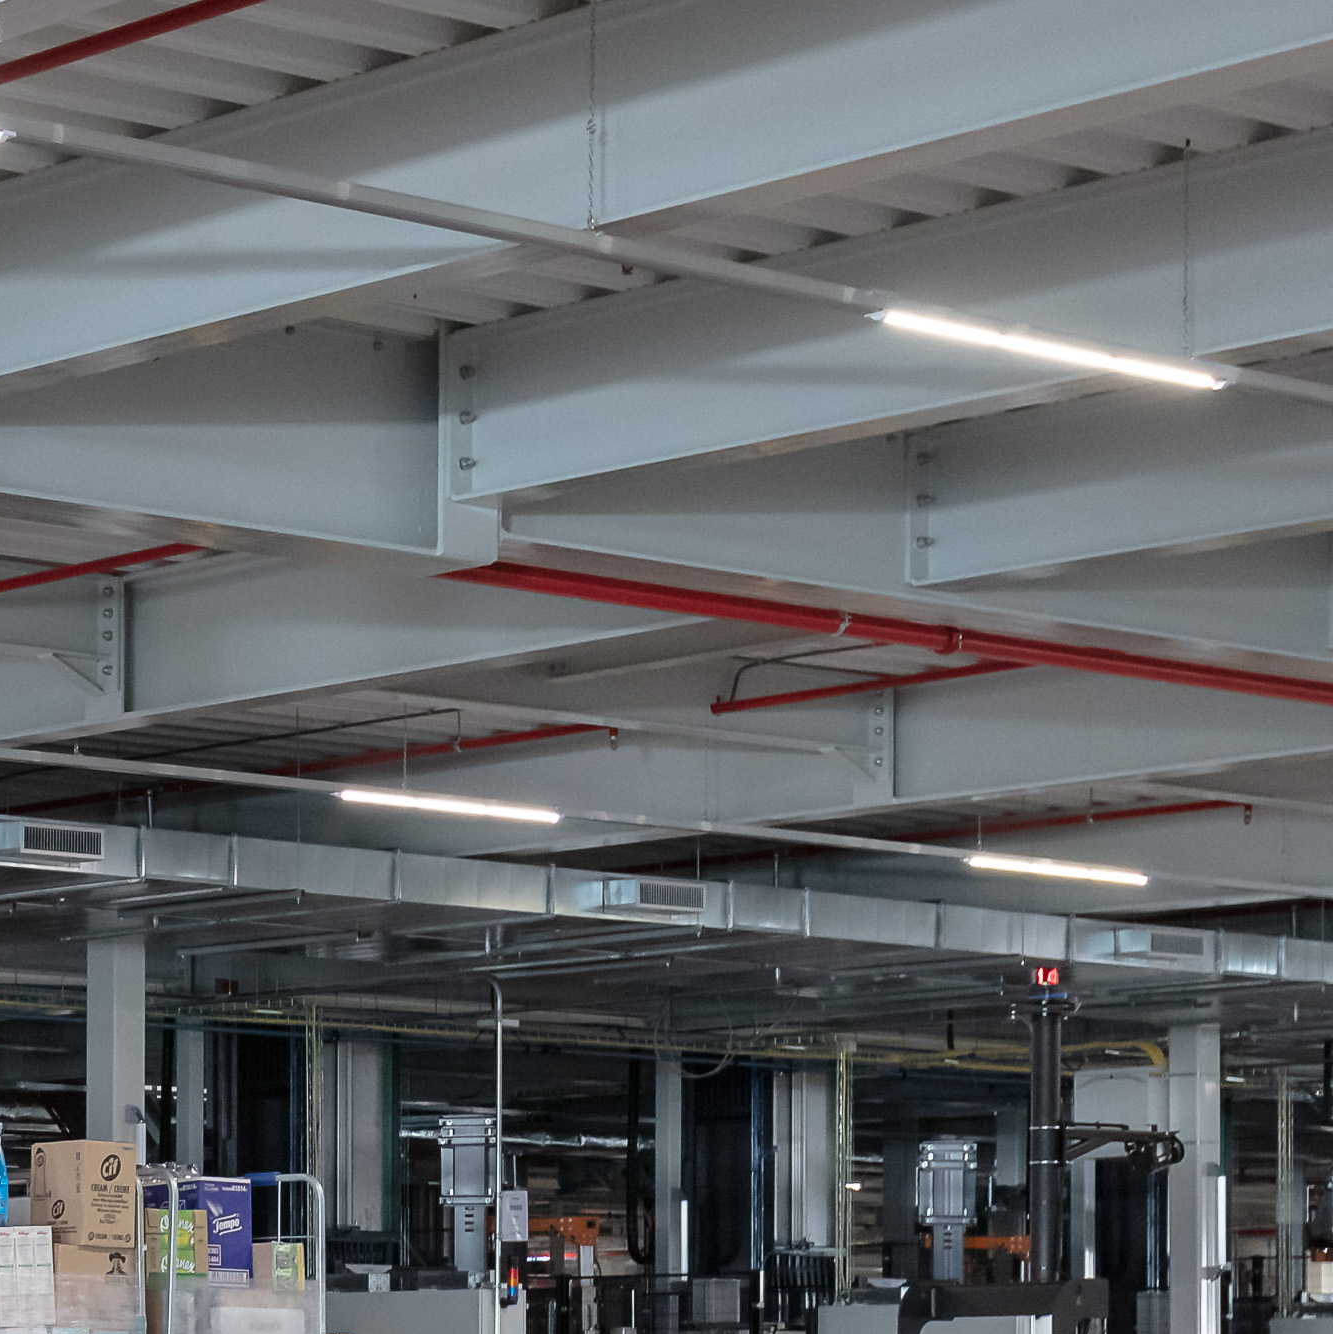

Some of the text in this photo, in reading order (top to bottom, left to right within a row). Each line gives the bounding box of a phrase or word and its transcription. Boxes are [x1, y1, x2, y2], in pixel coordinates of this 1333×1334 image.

[102, 1157, 119, 1178] cif
[90, 1184, 108, 1192] CREAM
[213, 1215, 240, 1234] Tempo
